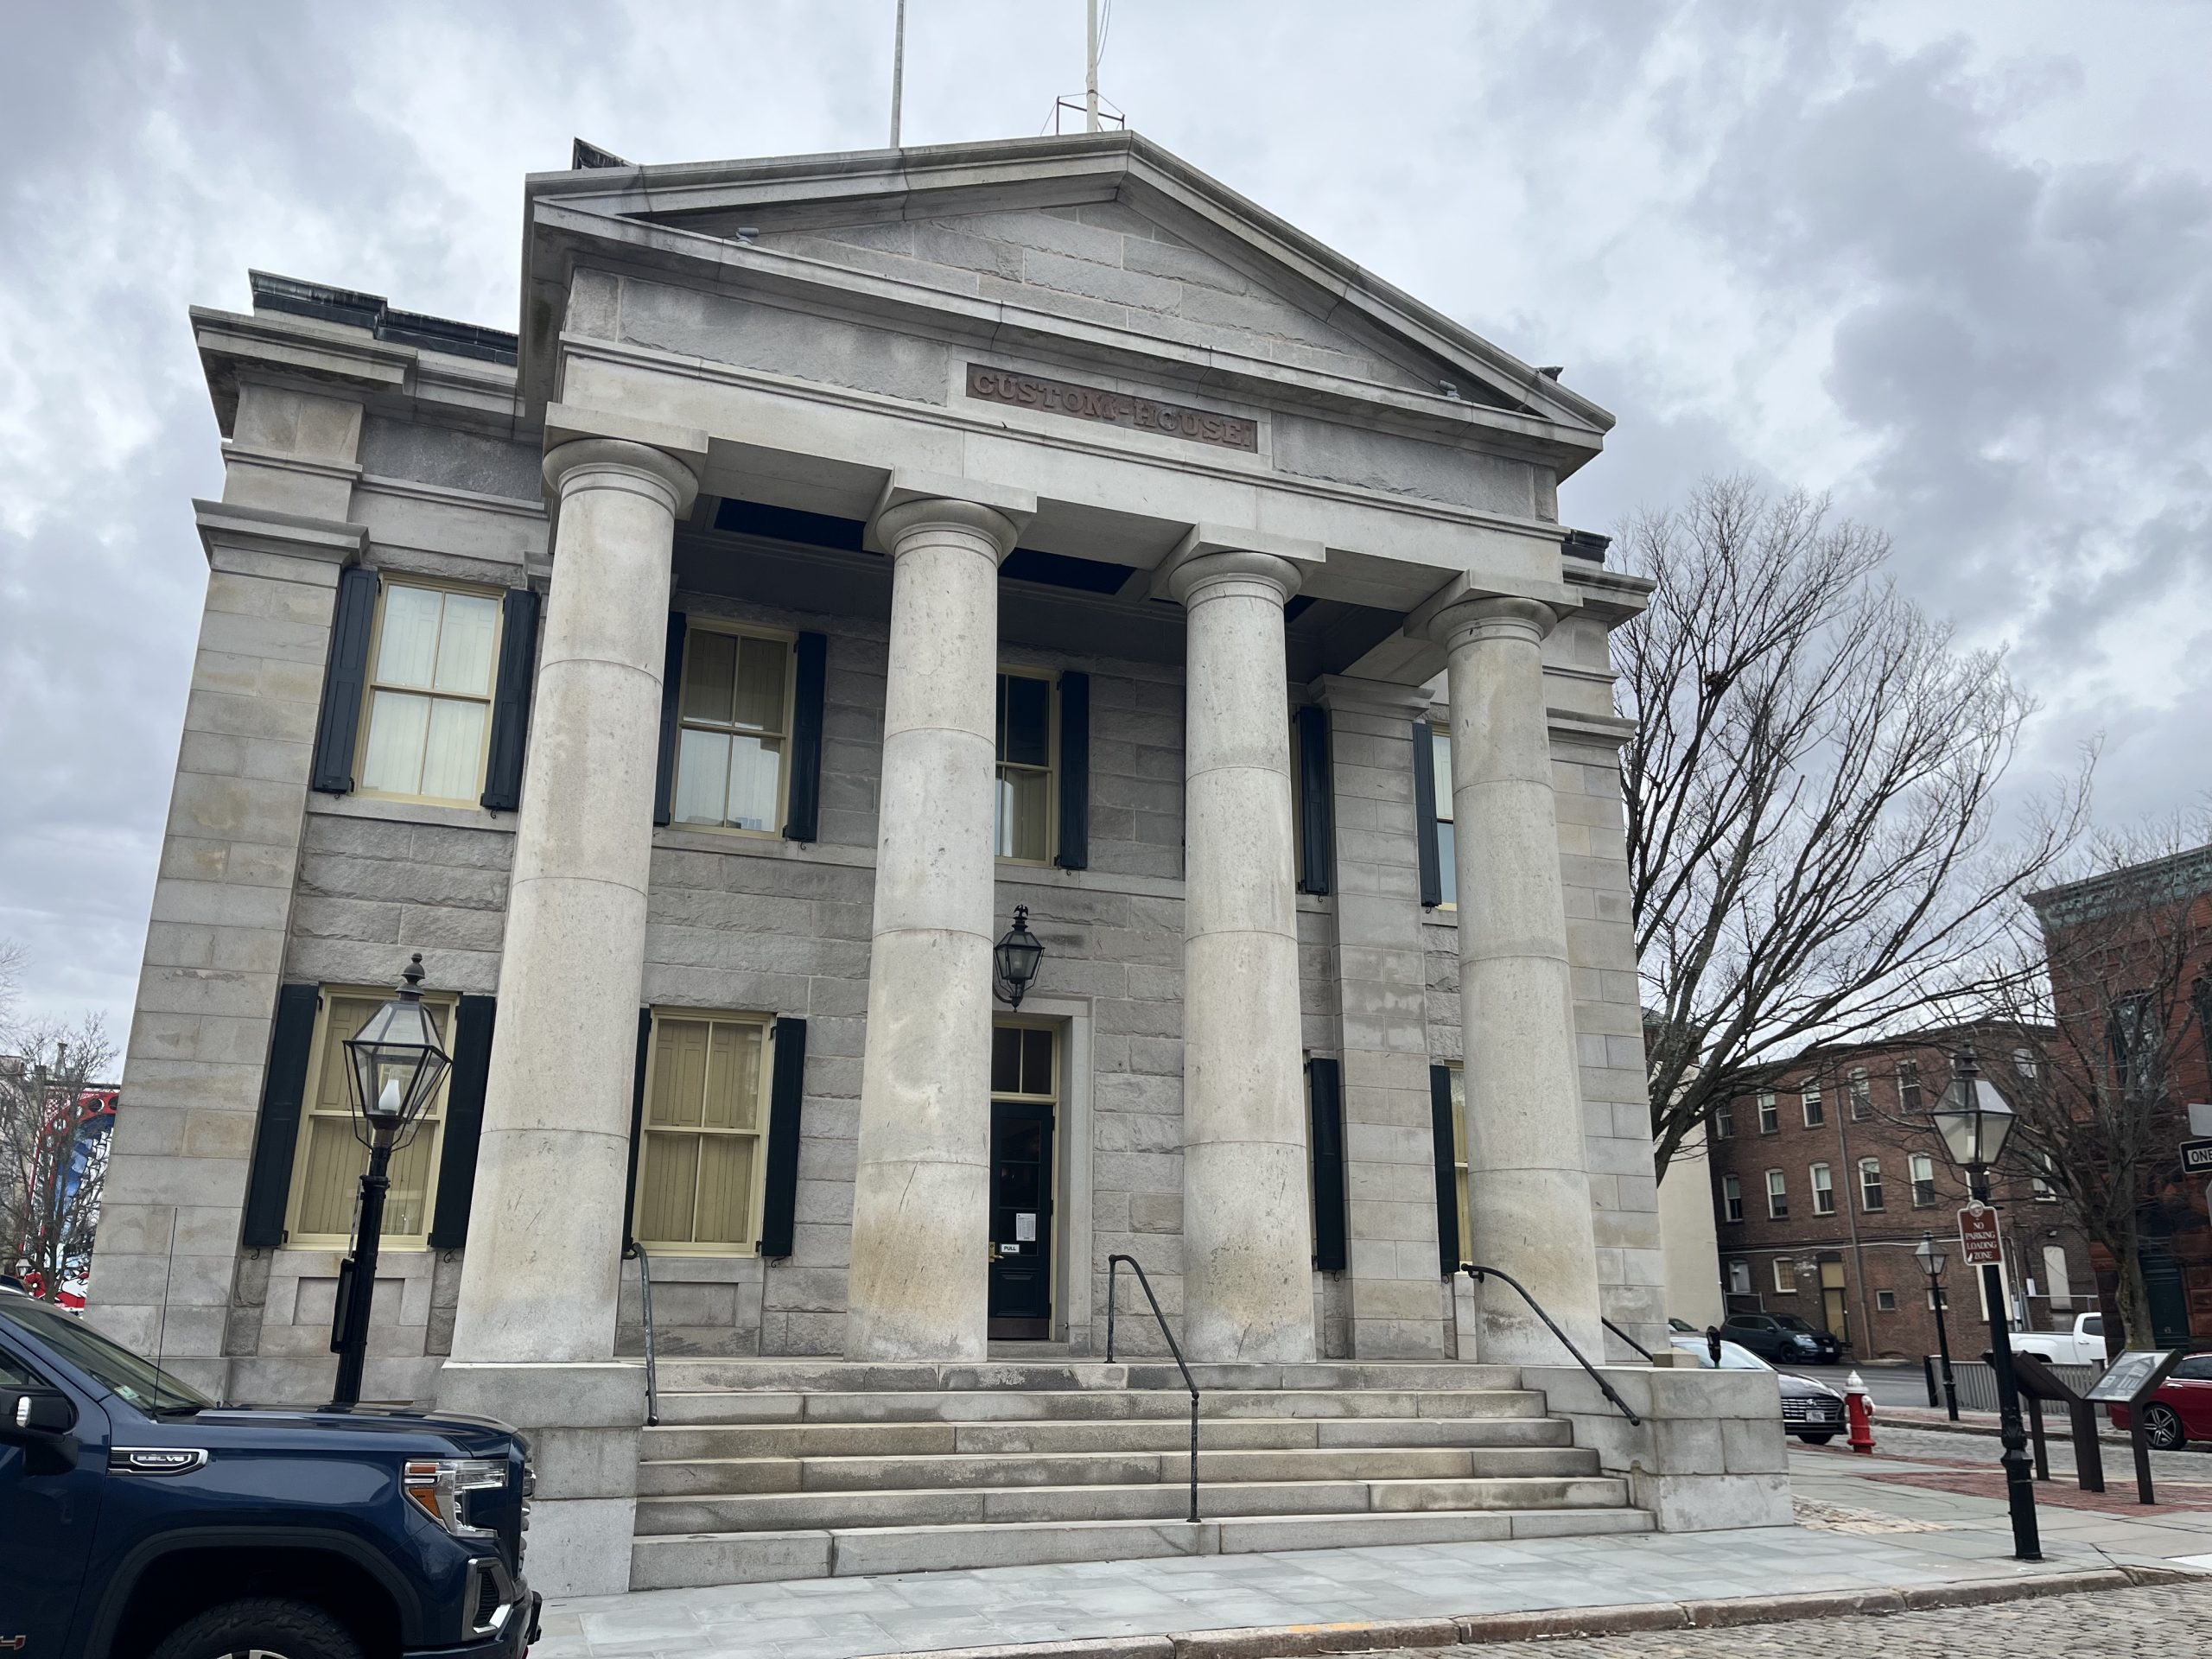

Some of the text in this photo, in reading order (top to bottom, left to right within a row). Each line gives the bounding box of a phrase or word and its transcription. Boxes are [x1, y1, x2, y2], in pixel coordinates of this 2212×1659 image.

[1973, 1221, 1985, 1230] NO
[1964, 1231, 1995, 1240] PARKING
[1966, 1241, 1998, 1250] LOADING
[1974, 1251, 1993, 1260] ZONE
